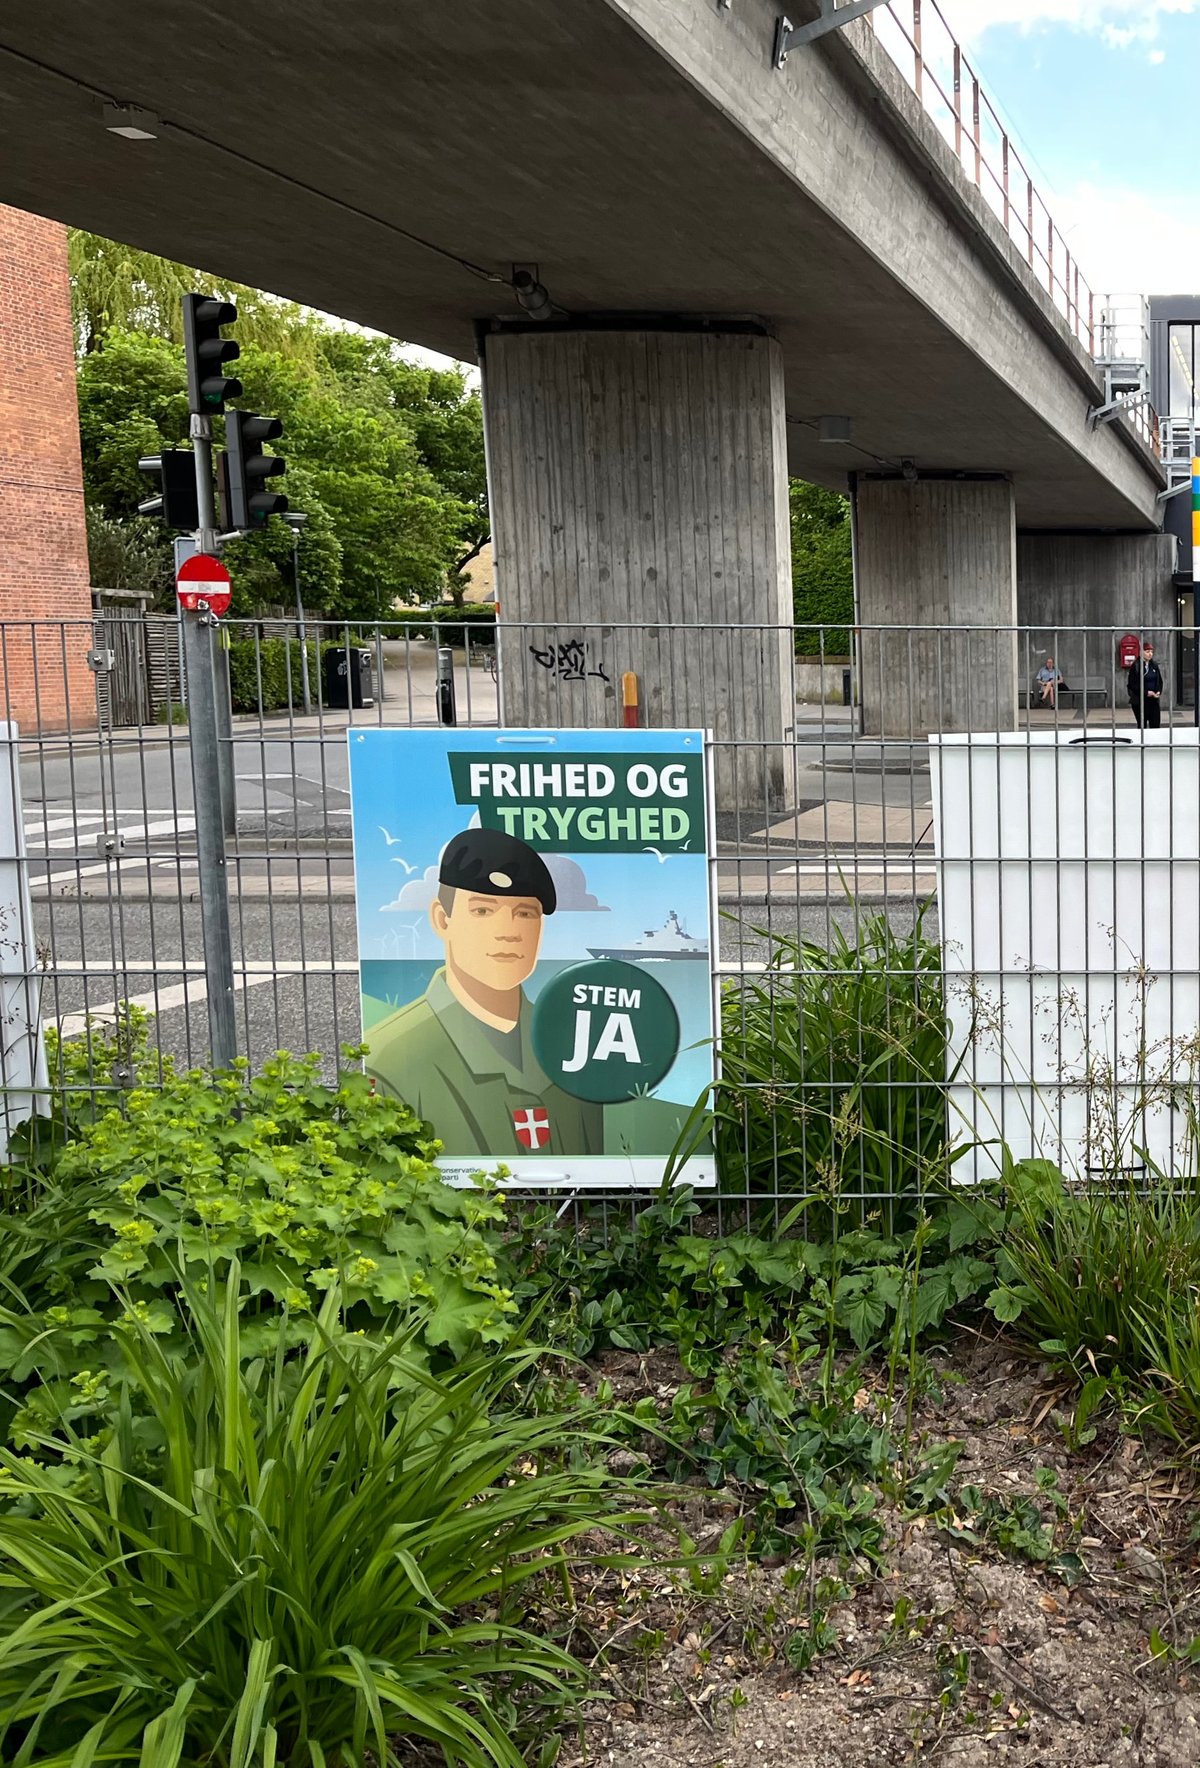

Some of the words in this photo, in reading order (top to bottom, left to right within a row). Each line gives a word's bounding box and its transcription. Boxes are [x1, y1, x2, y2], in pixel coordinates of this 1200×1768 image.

[469, 762, 615, 799] FRIHED
[626, 762, 688, 799] OG
[497, 806, 690, 841] TRYGHED
[572, 984, 641, 1009] STEM
[561, 1009, 642, 1073] JA
